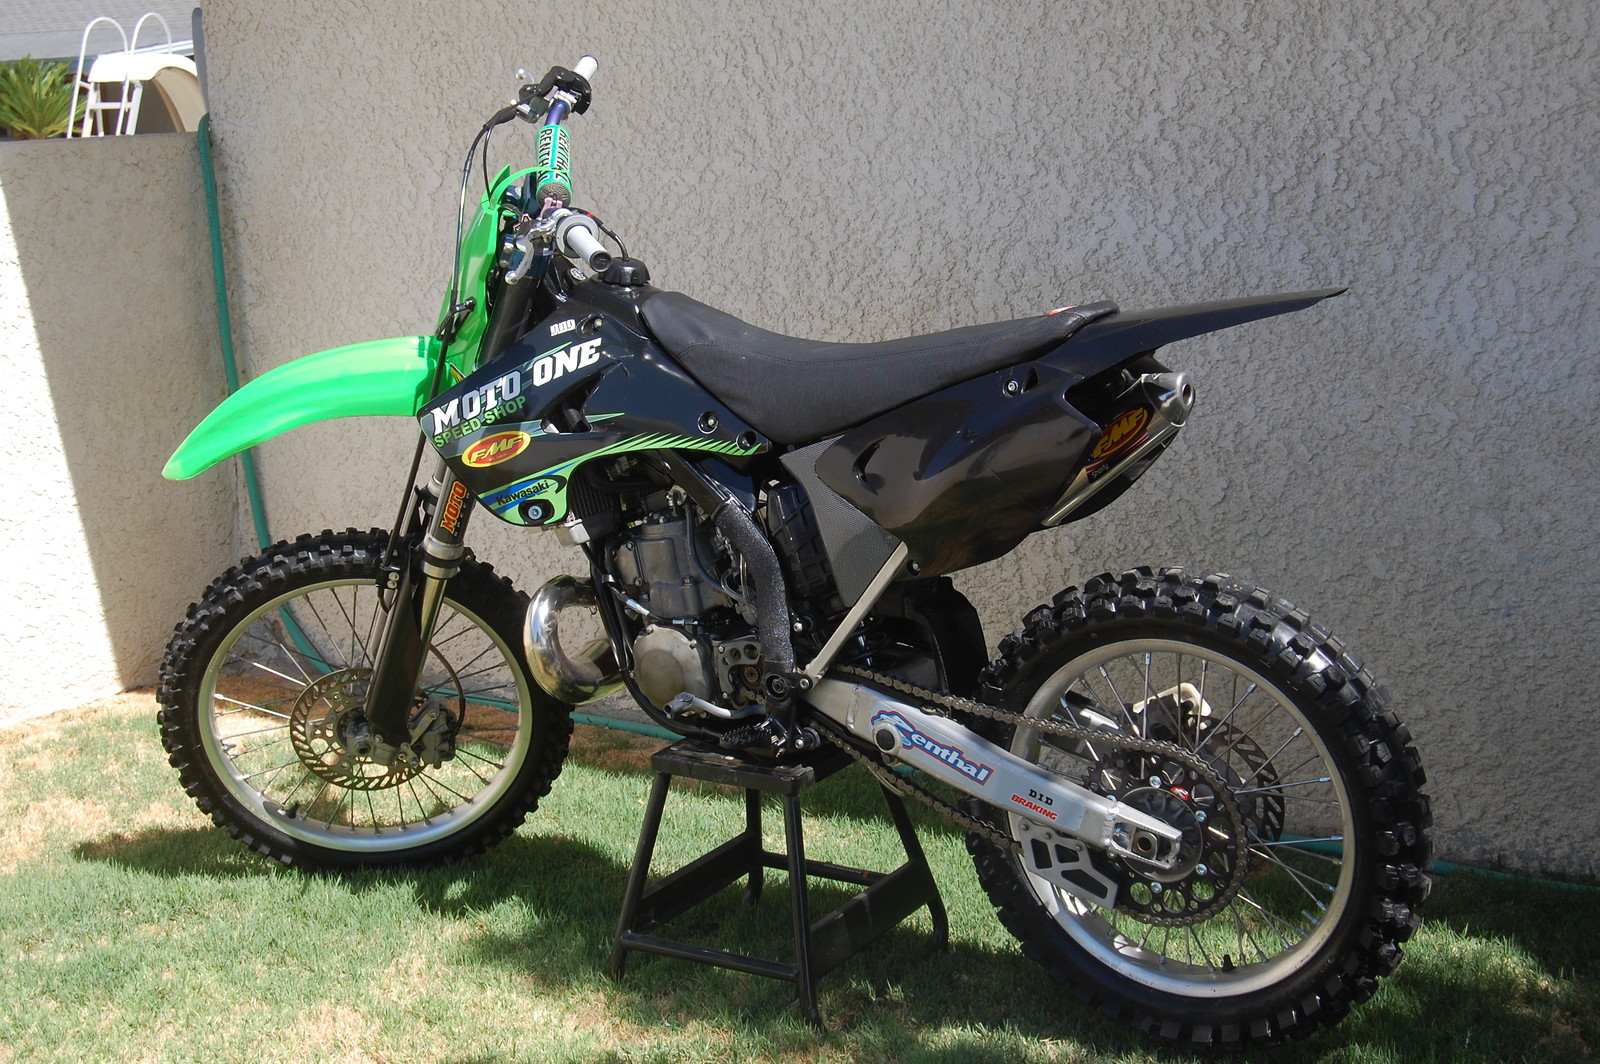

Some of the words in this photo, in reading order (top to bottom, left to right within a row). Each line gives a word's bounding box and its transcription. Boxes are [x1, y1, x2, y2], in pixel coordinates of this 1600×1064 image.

[431, 370, 521, 436] MOTO
[533, 337, 602, 387] ONE
[434, 417, 482, 448] SPEED
[484, 395, 526, 424] SHOP
[1091, 406, 1144, 459] FMF
[469, 433, 525, 464] FMF
[440, 481, 467, 535] MOTO
[496, 480, 550, 506] Kawasaki
[1010, 793, 1059, 820] BRAKING
